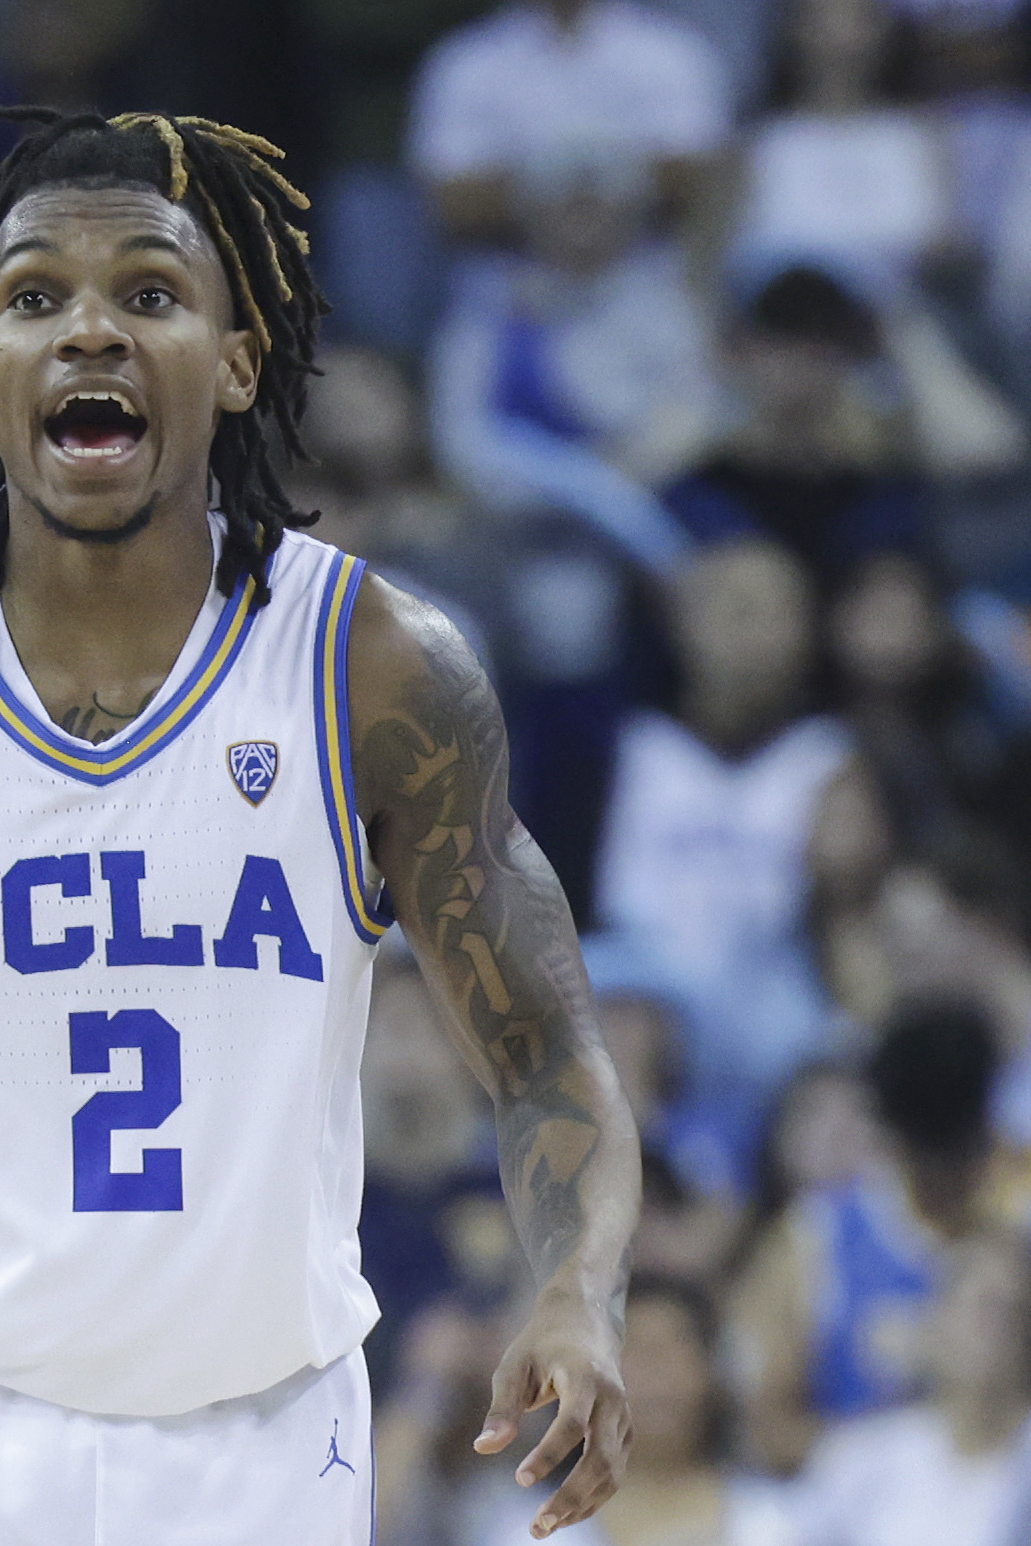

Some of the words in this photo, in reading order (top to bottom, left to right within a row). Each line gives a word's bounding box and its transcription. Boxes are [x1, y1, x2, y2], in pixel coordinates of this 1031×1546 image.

[230, 744, 276, 781] PAC
[243, 768, 266, 792] 12
[69, 1009, 183, 1212] 2
